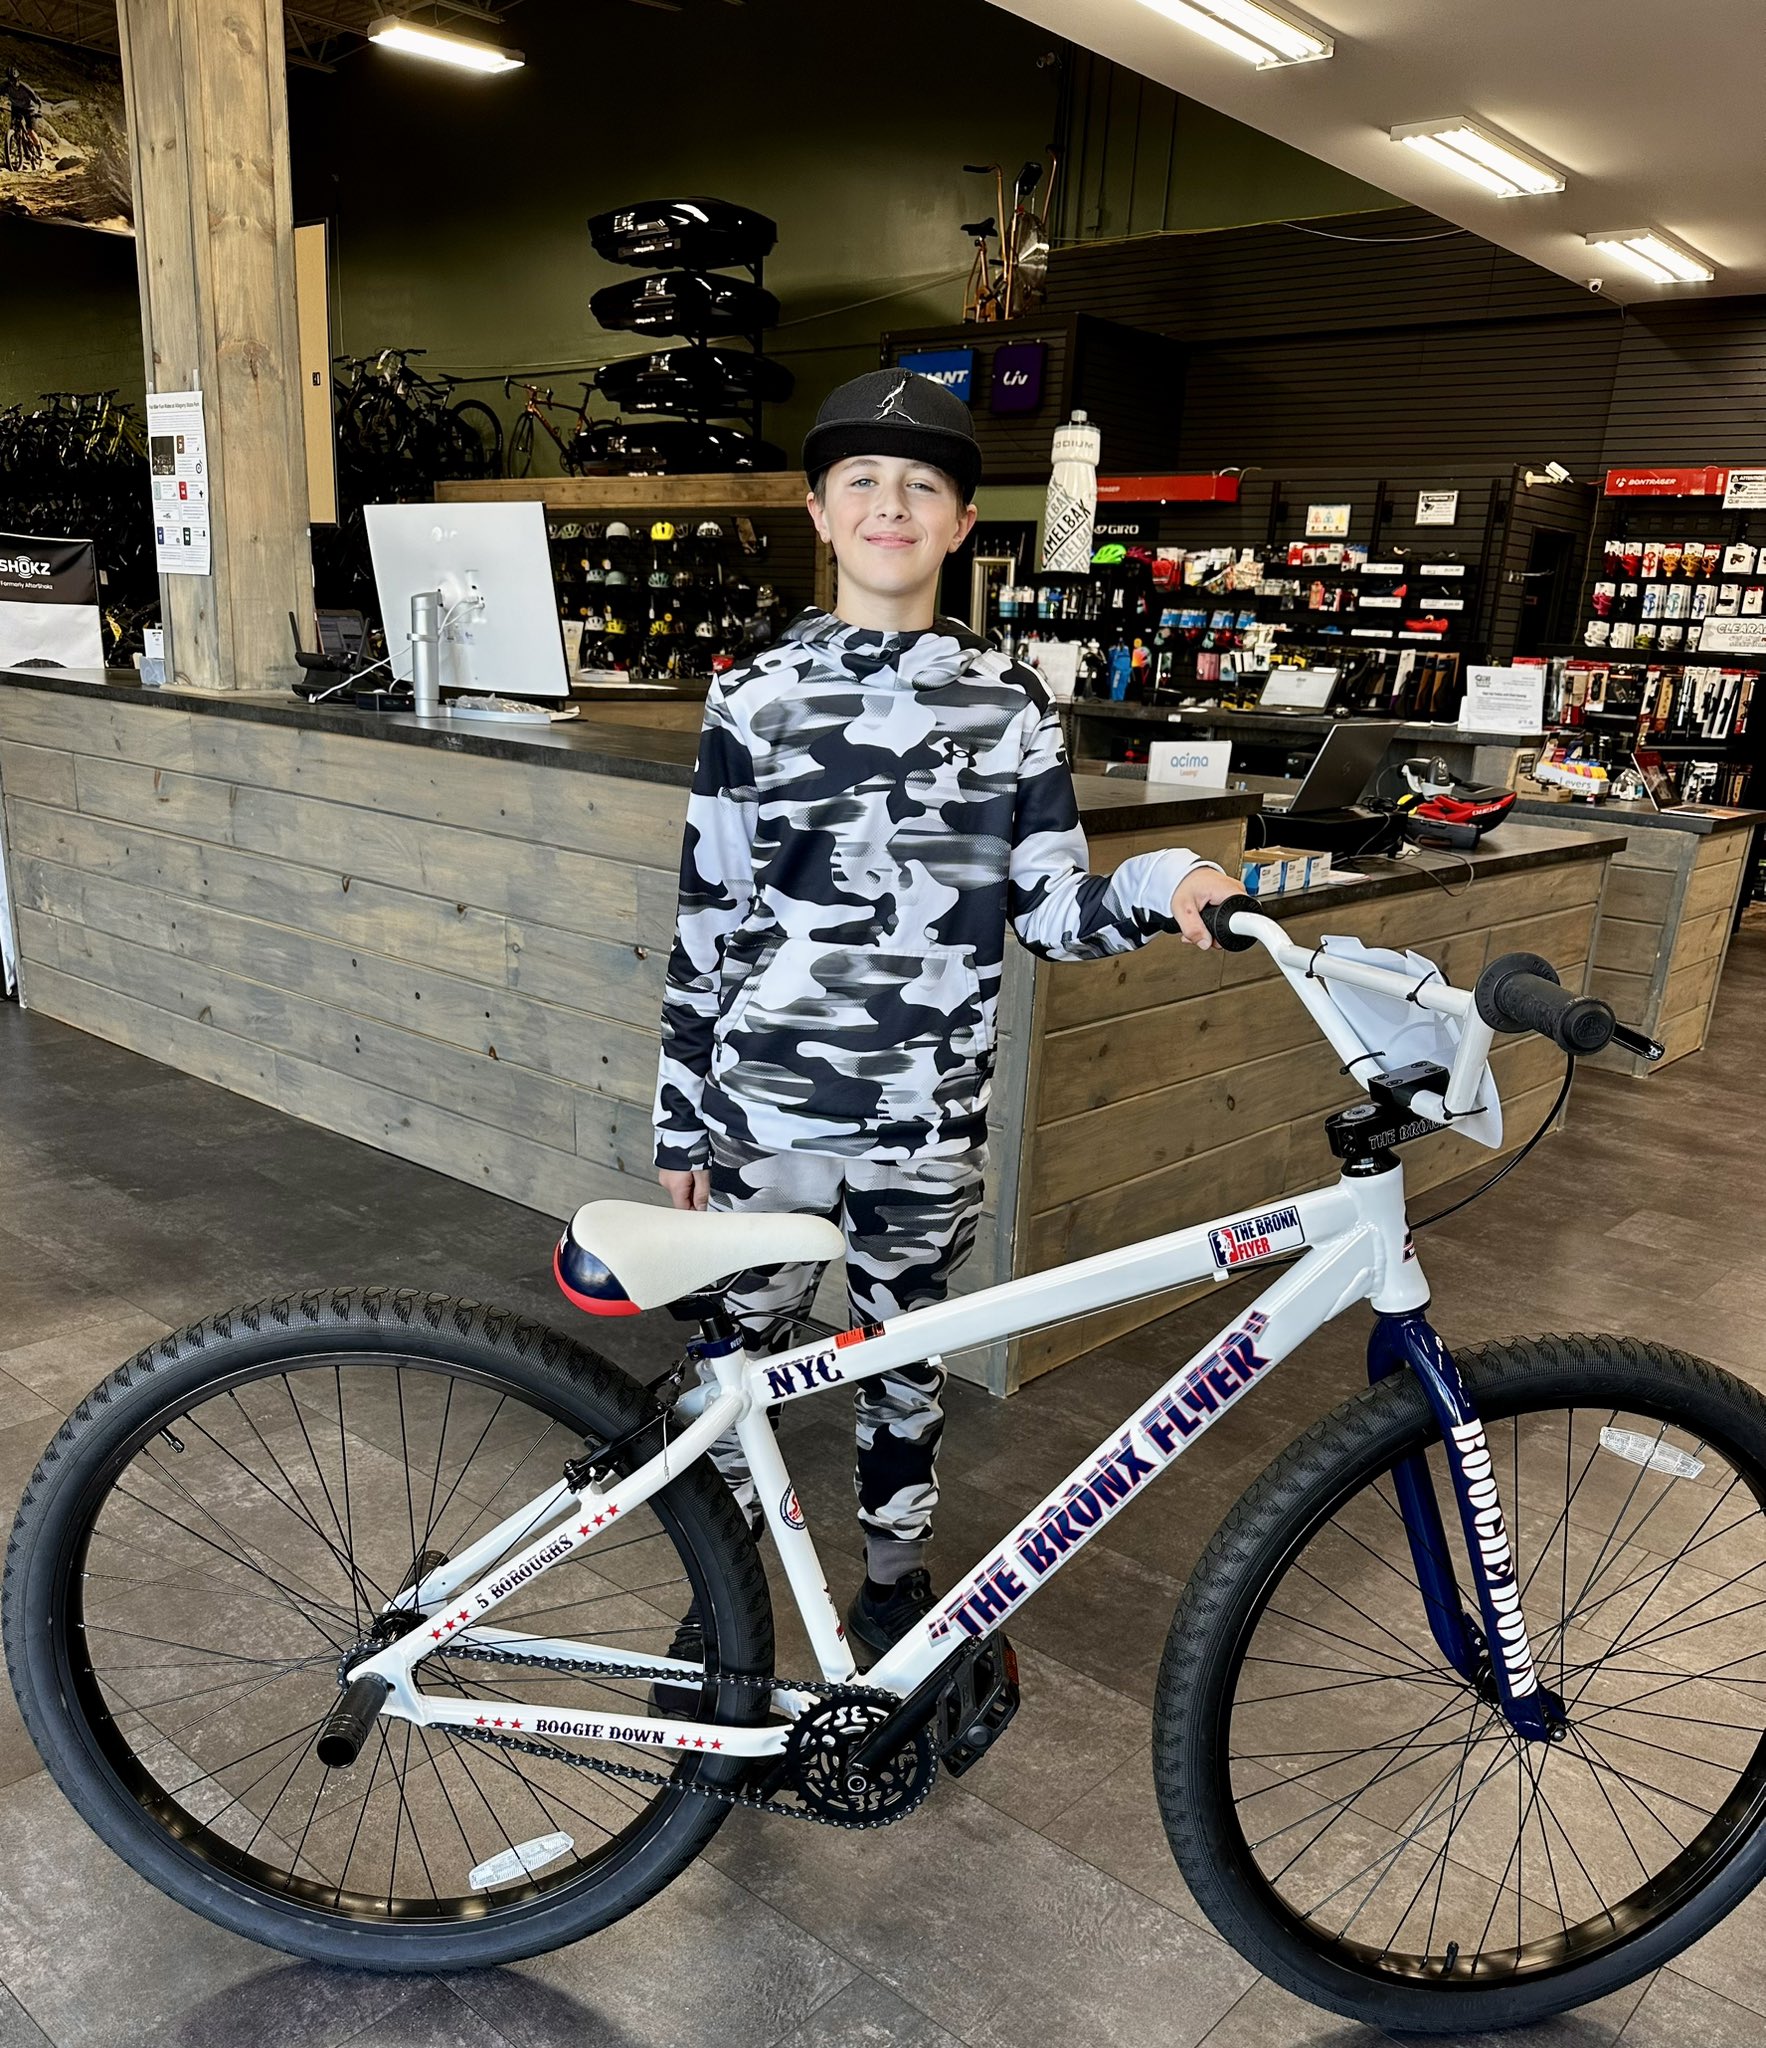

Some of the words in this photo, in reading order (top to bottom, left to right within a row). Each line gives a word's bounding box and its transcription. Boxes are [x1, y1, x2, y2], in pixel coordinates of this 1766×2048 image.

[1003, 370, 1028, 386] Liv
[1628, 478, 1677, 486] BONTRAGER
[1107, 524, 1140, 535] GIRO
[0, 556, 51, 578] SHOKZ
[1170, 752, 1209, 768] acima
[1368, 1128, 1396, 1150] THE
[1231, 1220, 1258, 1243] THE
[1255, 1208, 1299, 1237] BRONX
[1236, 1236, 1271, 1261] FLYER
[763, 1349, 845, 1400] NYC
[1013, 1428, 1158, 1578] BRONX
[1450, 1417, 1515, 1582] BOOGIE
[1488, 1578, 1539, 1699] DOWN
[474, 1592, 490, 1610] 5
[487, 1532, 574, 1601] BOROUGHS
[535, 1718, 604, 1739] BOOGIE
[608, 1726, 666, 1745] DOWN
